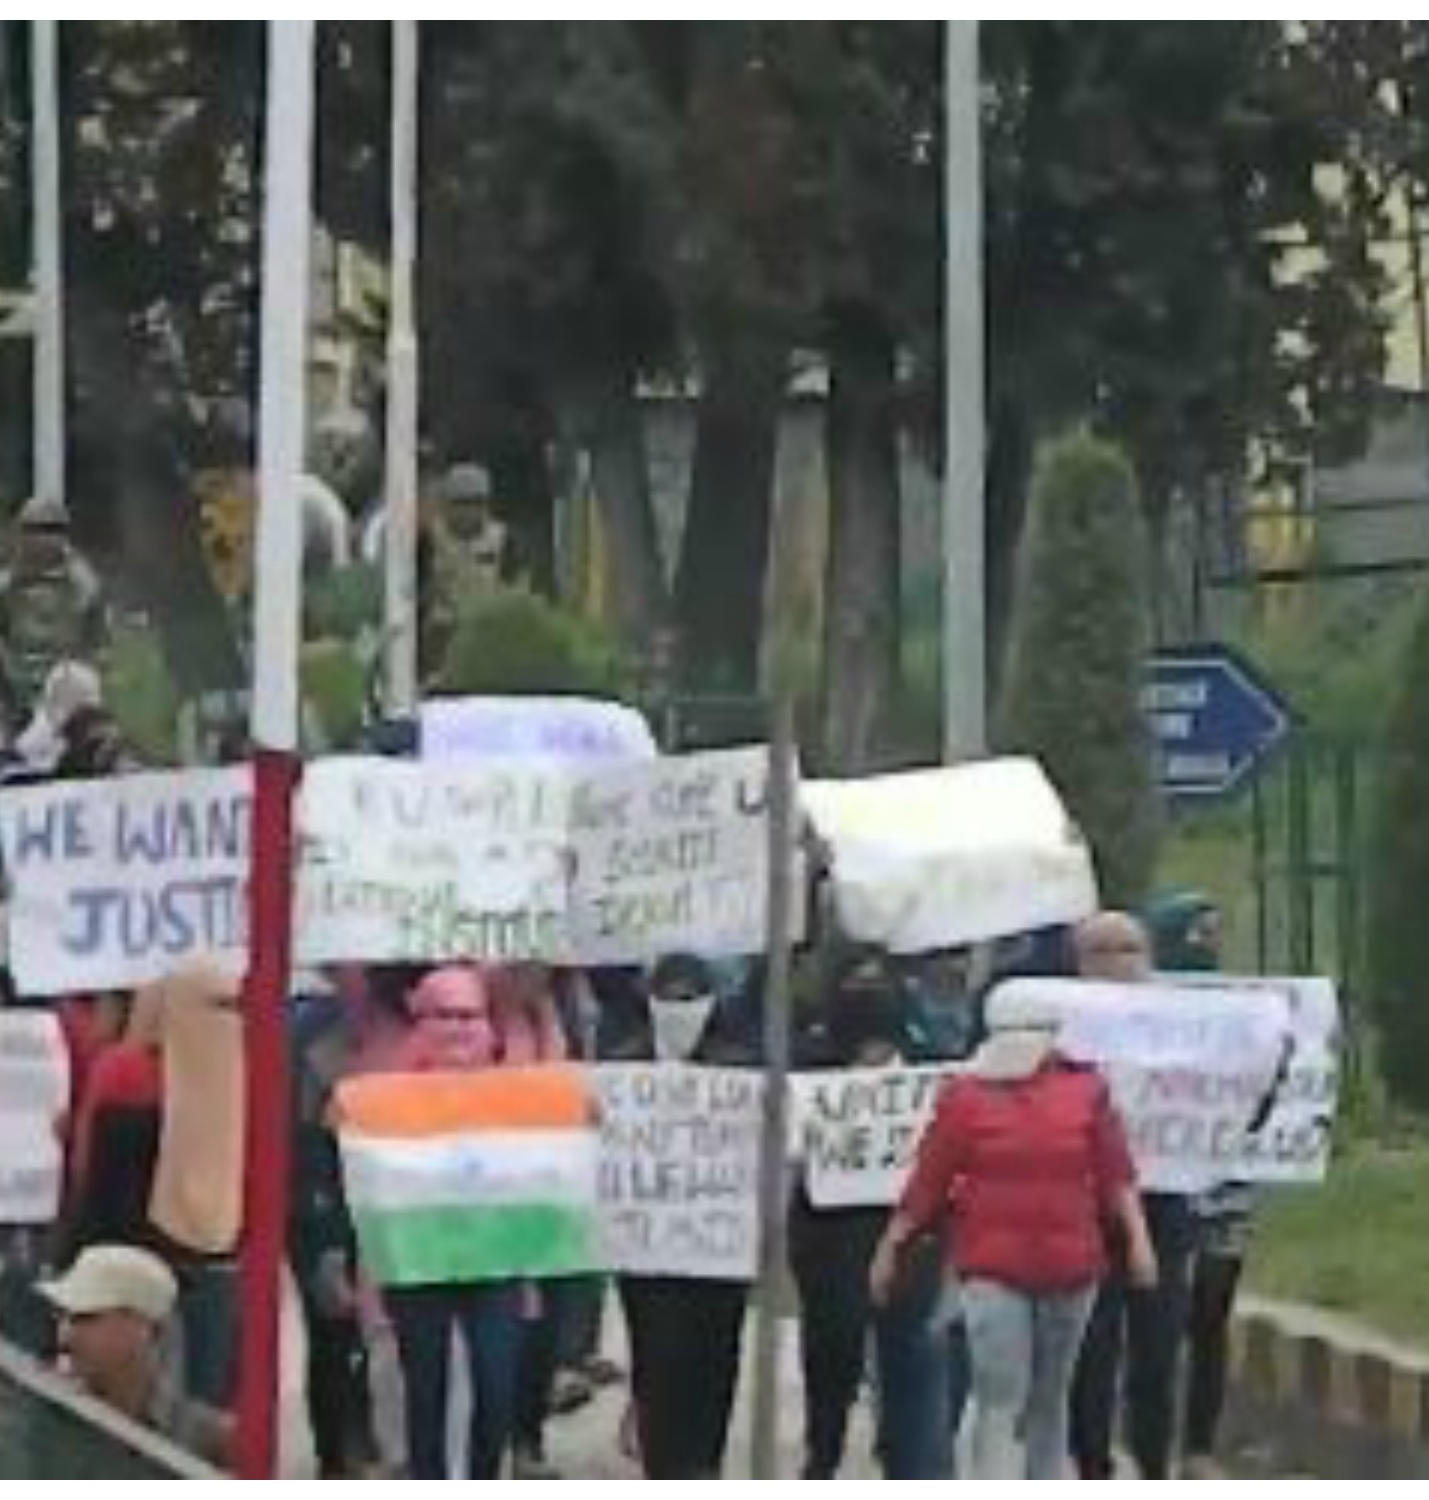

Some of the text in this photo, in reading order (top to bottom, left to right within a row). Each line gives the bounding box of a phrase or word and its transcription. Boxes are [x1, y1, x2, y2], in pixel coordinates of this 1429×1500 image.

[13, 796, 94, 866] WE
[115, 792, 248, 866] WAN
[58, 875, 240, 958] JUSTI
